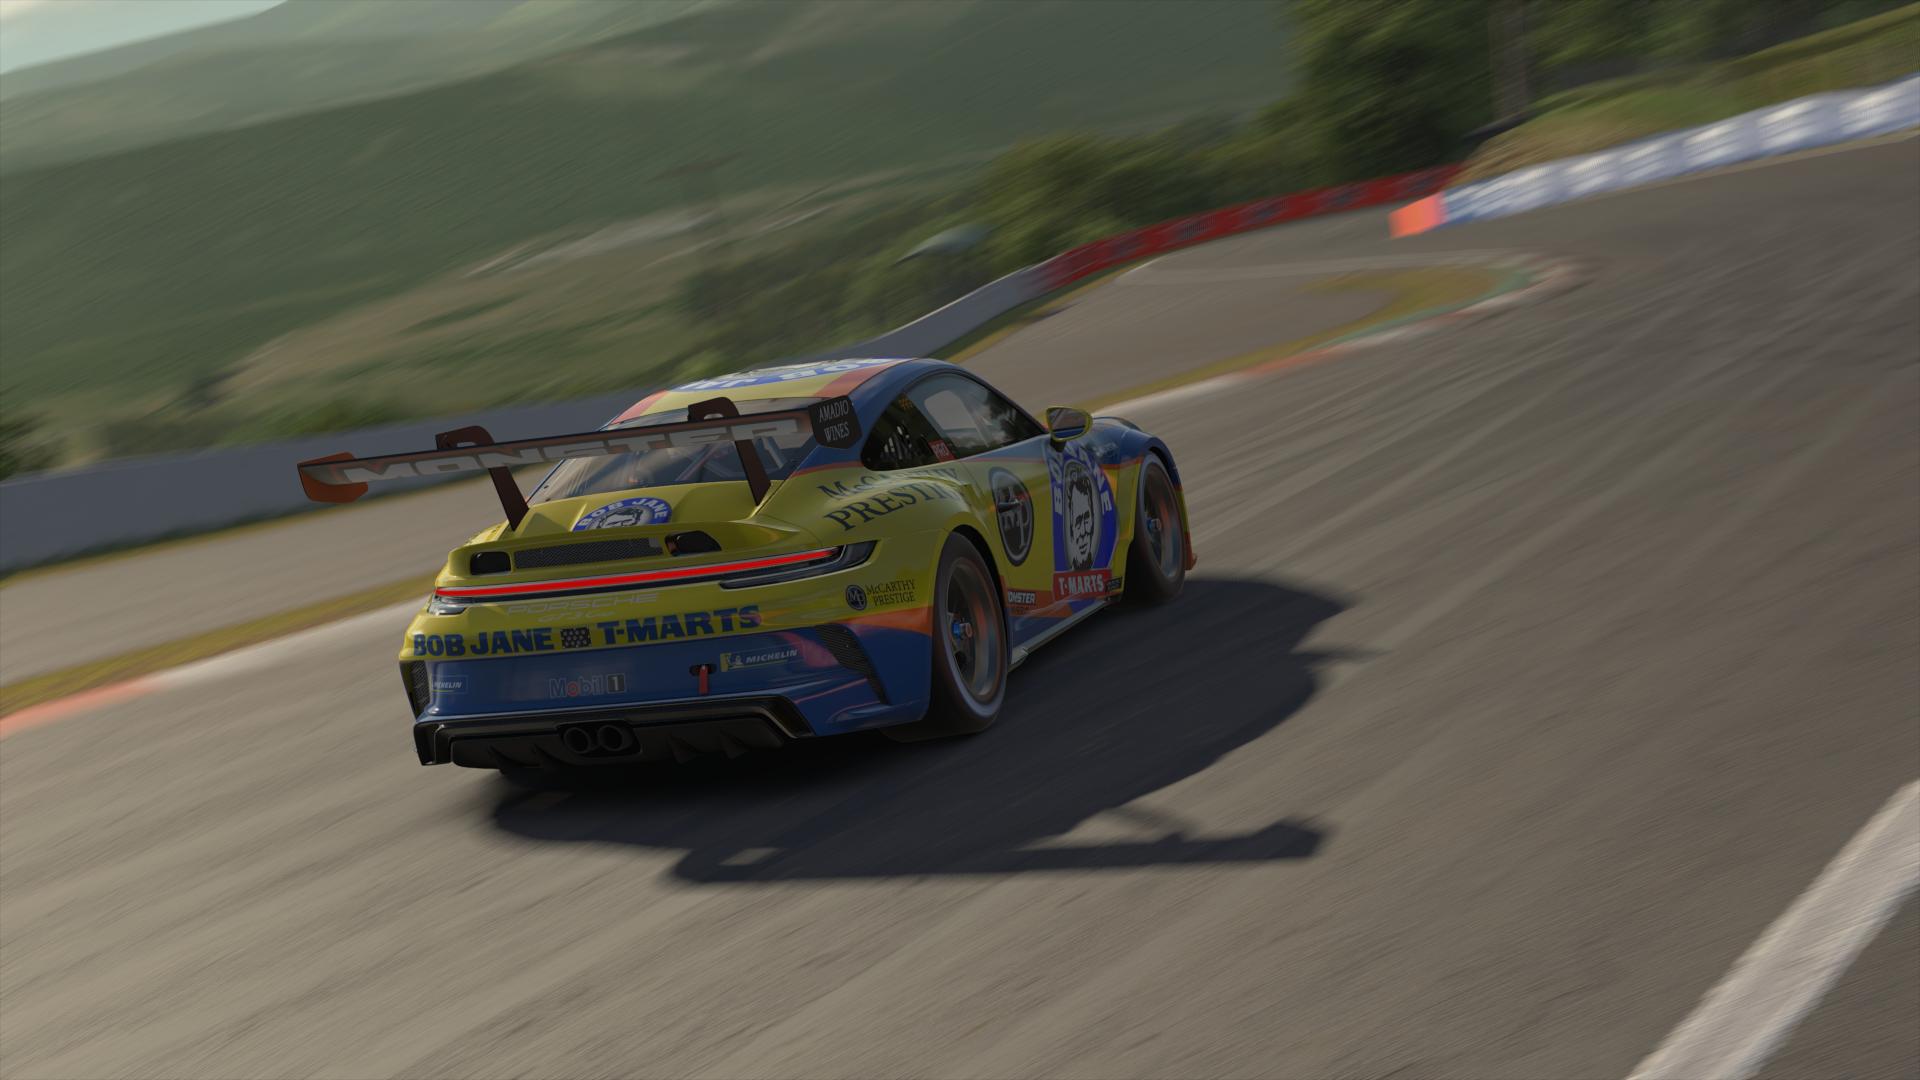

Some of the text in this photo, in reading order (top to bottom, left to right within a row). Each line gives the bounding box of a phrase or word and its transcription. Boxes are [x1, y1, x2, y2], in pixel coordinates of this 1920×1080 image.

[818, 400, 849, 423] AMADIO
[824, 422, 850, 442] WINES
[342, 418, 798, 483] MONSTER
[871, 591, 915, 607] PRESTIGE
[1007, 591, 1036, 604] ONSTER
[414, 634, 465, 656] BOB
[471, 627, 554, 655] JANE
[745, 649, 799, 665] MICHELIN
[550, 674, 602, 698] Mobil
